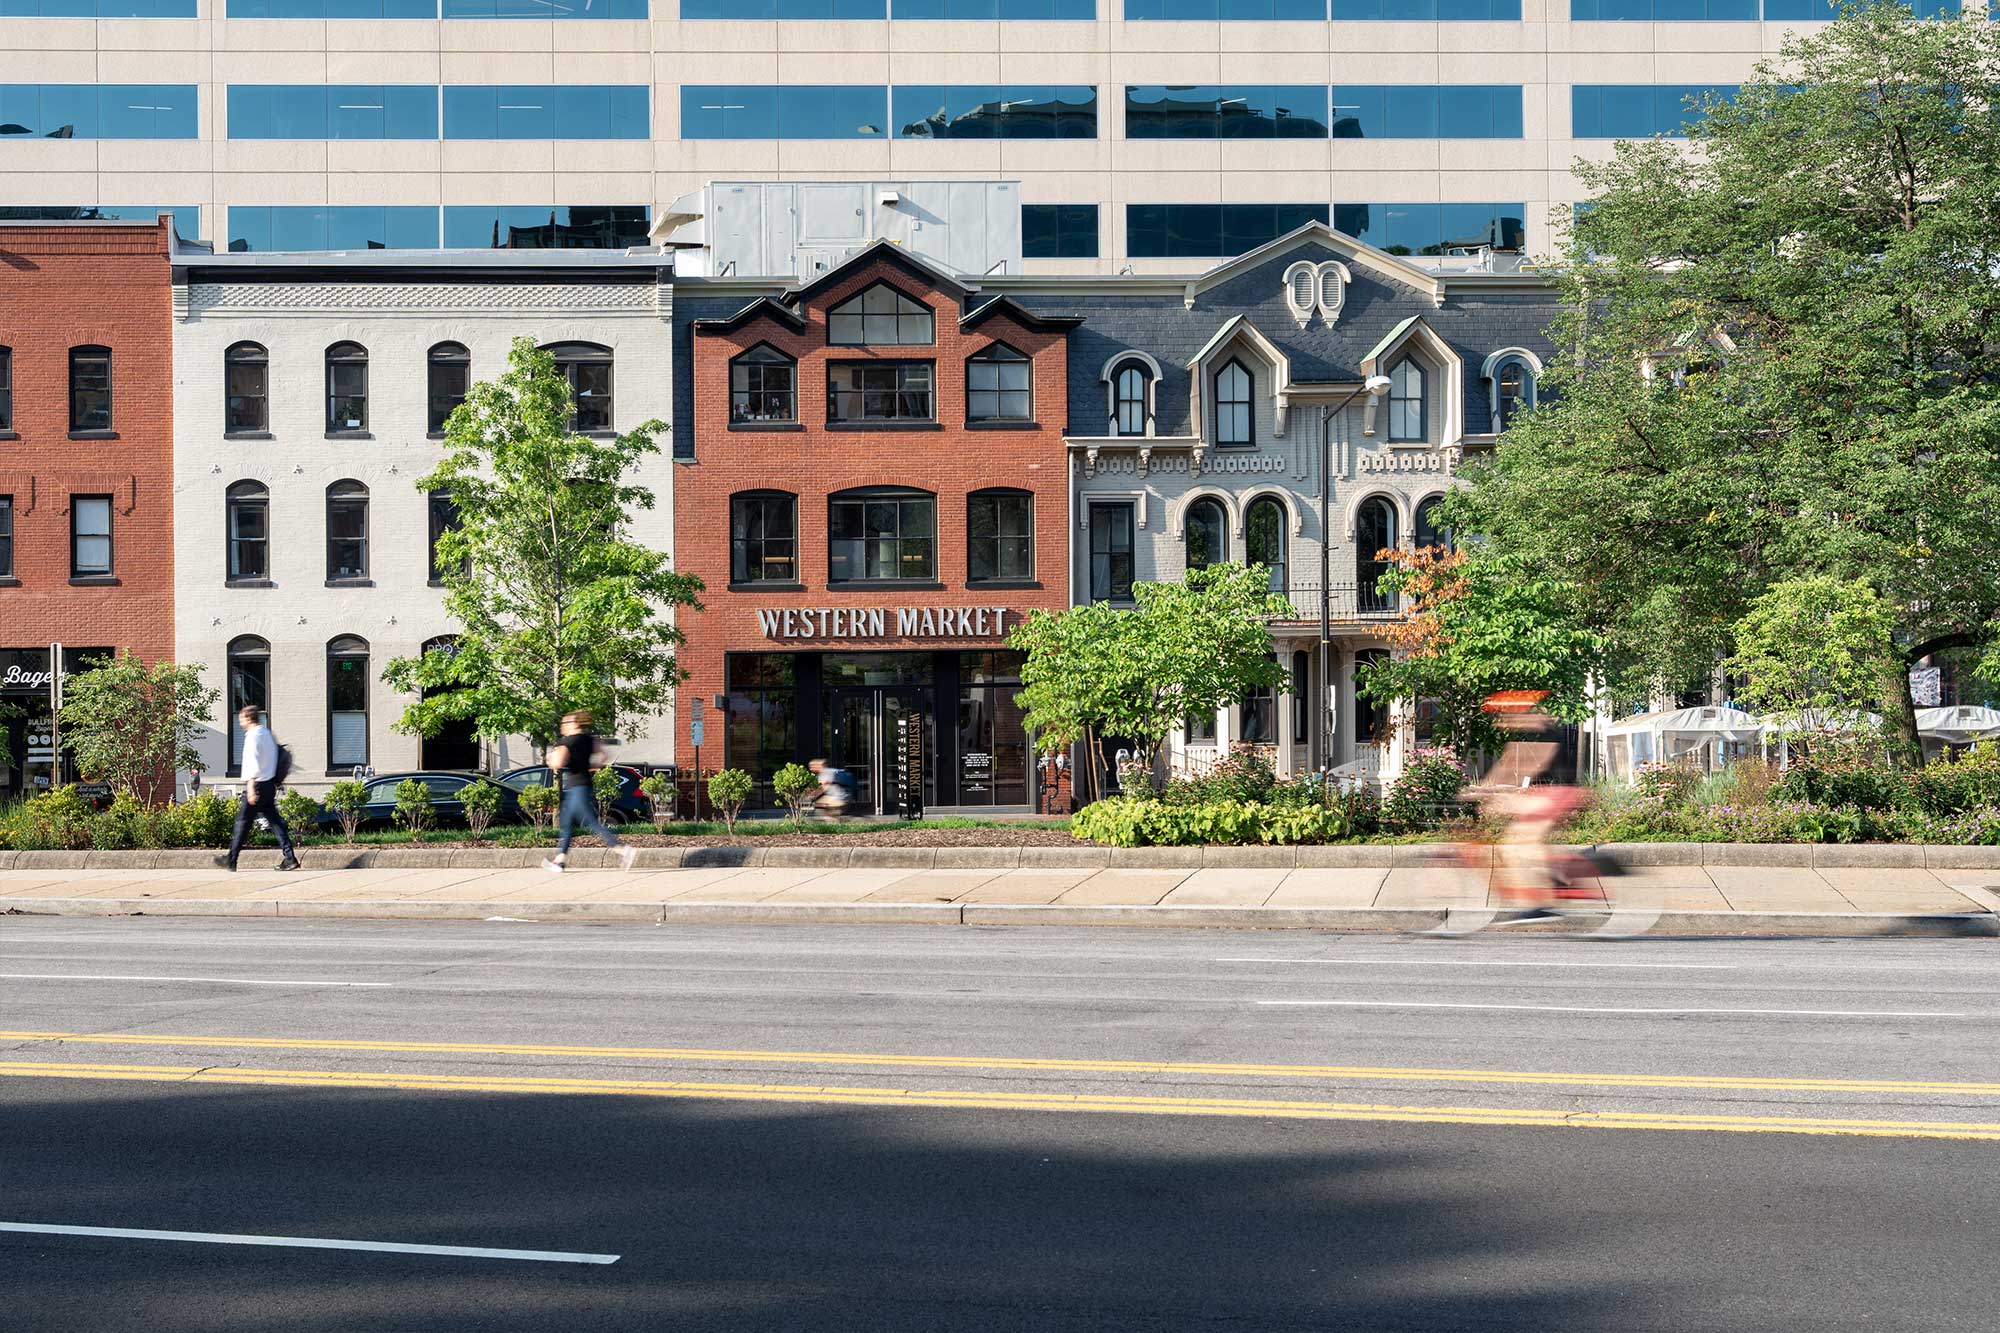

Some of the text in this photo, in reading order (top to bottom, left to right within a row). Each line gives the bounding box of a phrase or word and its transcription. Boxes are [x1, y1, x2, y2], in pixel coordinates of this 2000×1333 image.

[757, 607, 1006, 638] WESTERN MARKET
[909, 712, 920, 797] WESTERN MARKET
